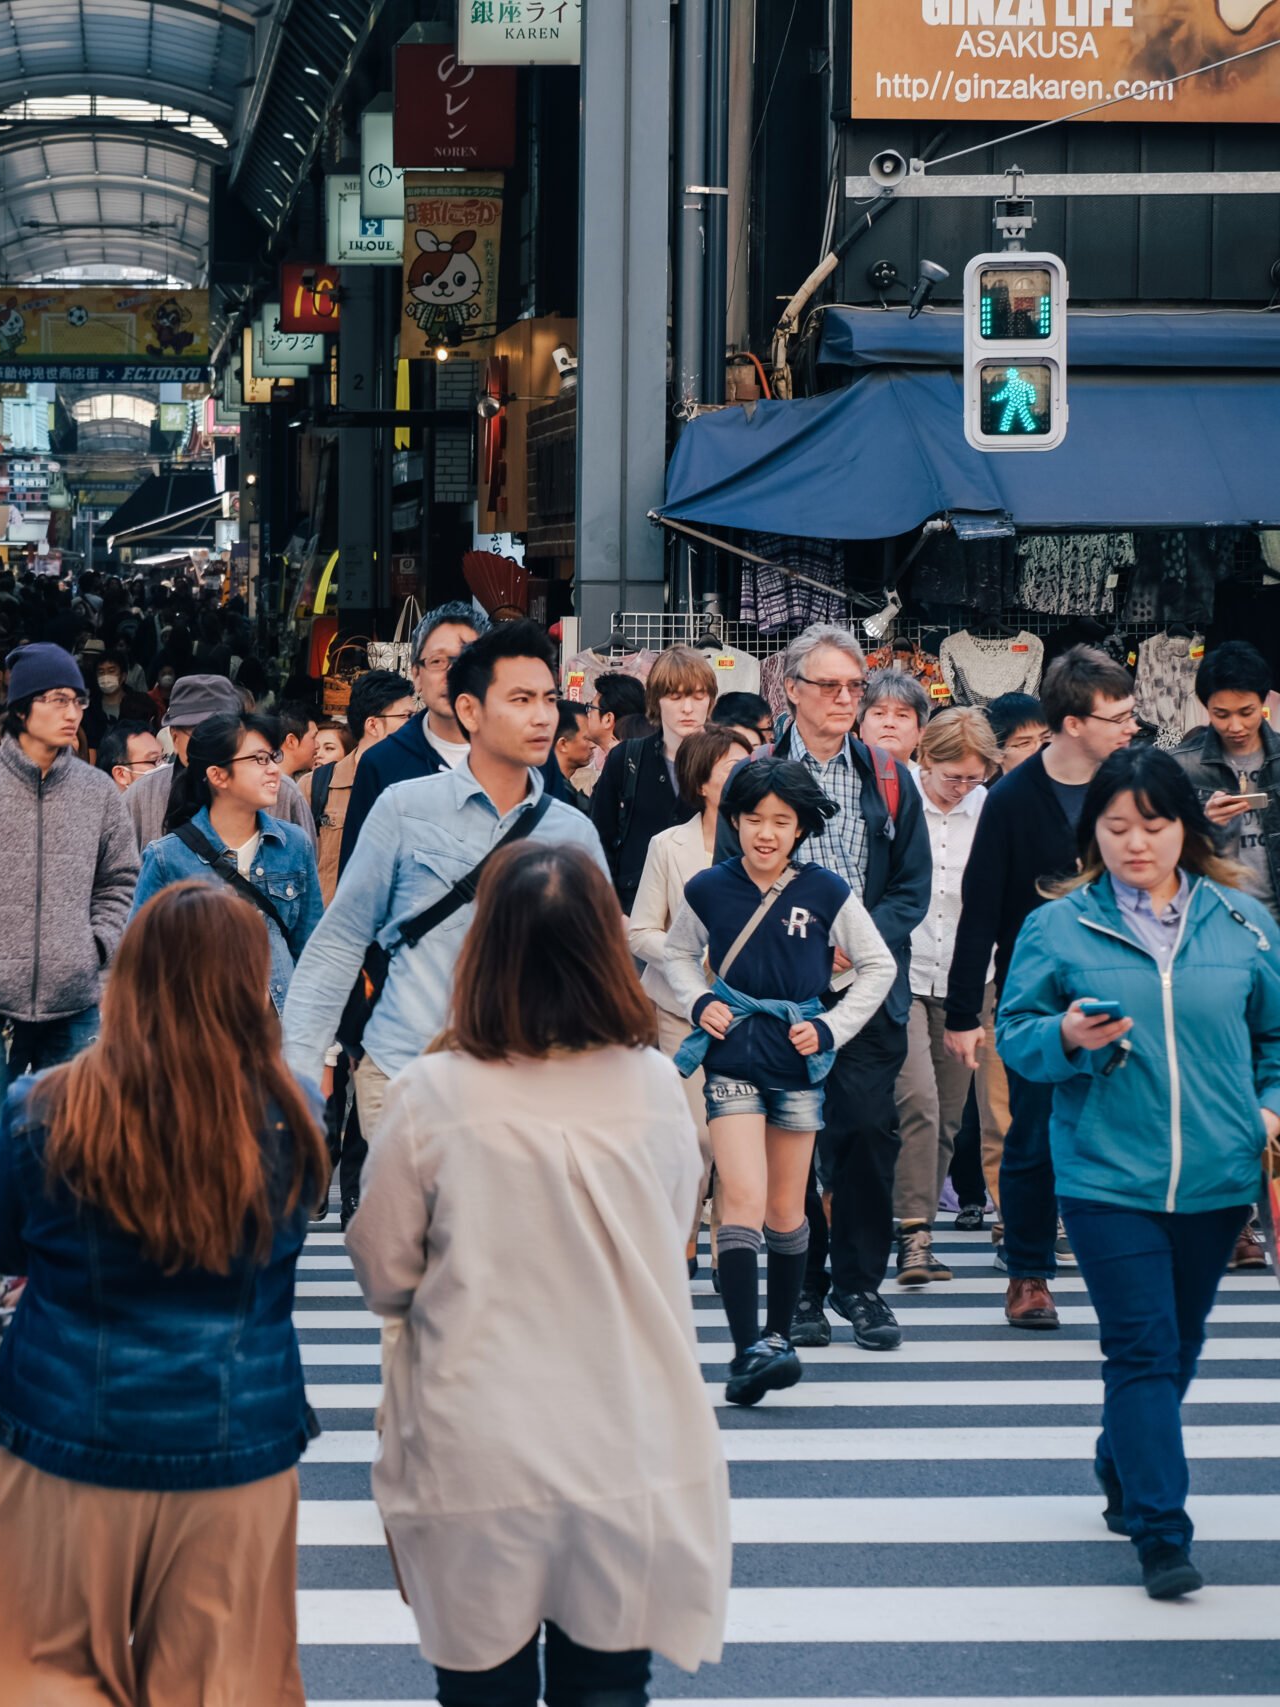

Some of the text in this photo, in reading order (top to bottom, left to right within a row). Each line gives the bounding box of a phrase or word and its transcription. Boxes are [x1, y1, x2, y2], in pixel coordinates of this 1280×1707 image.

[470, 0, 582, 24] 銀座ライ
[921, 0, 1134, 27] GINZA LIFE
[505, 27, 560, 39] KAREN
[955, 30, 1099, 59] ASAKUSA
[433, 147, 477, 157] NOREN
[787, 906, 809, 939] R
